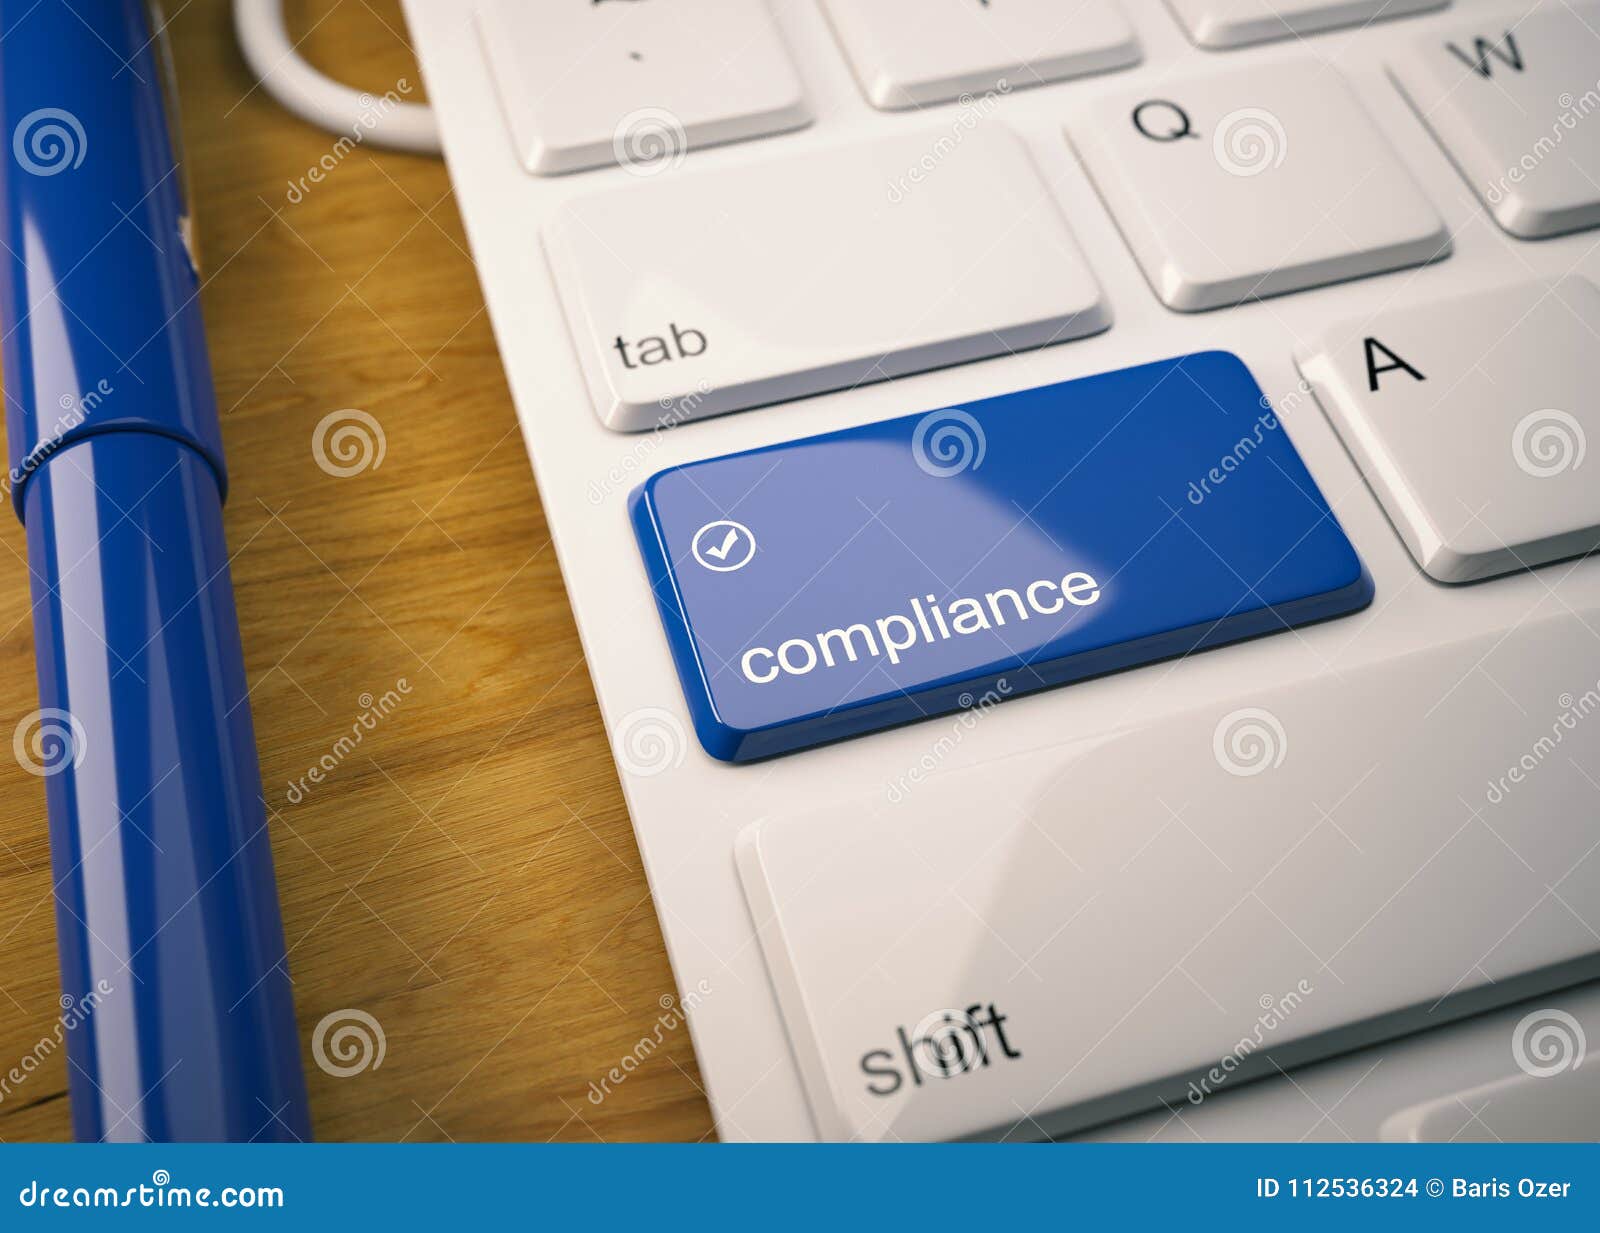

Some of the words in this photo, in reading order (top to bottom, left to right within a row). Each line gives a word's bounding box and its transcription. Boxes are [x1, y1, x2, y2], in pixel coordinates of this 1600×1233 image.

[1446, 31, 1525, 79] W
[1132, 99, 1200, 143] Q
[613, 322, 708, 370] tab
[1364, 337, 1427, 392] A
[741, 570, 1101, 684] compliance
[860, 1003, 1022, 1096] shift
